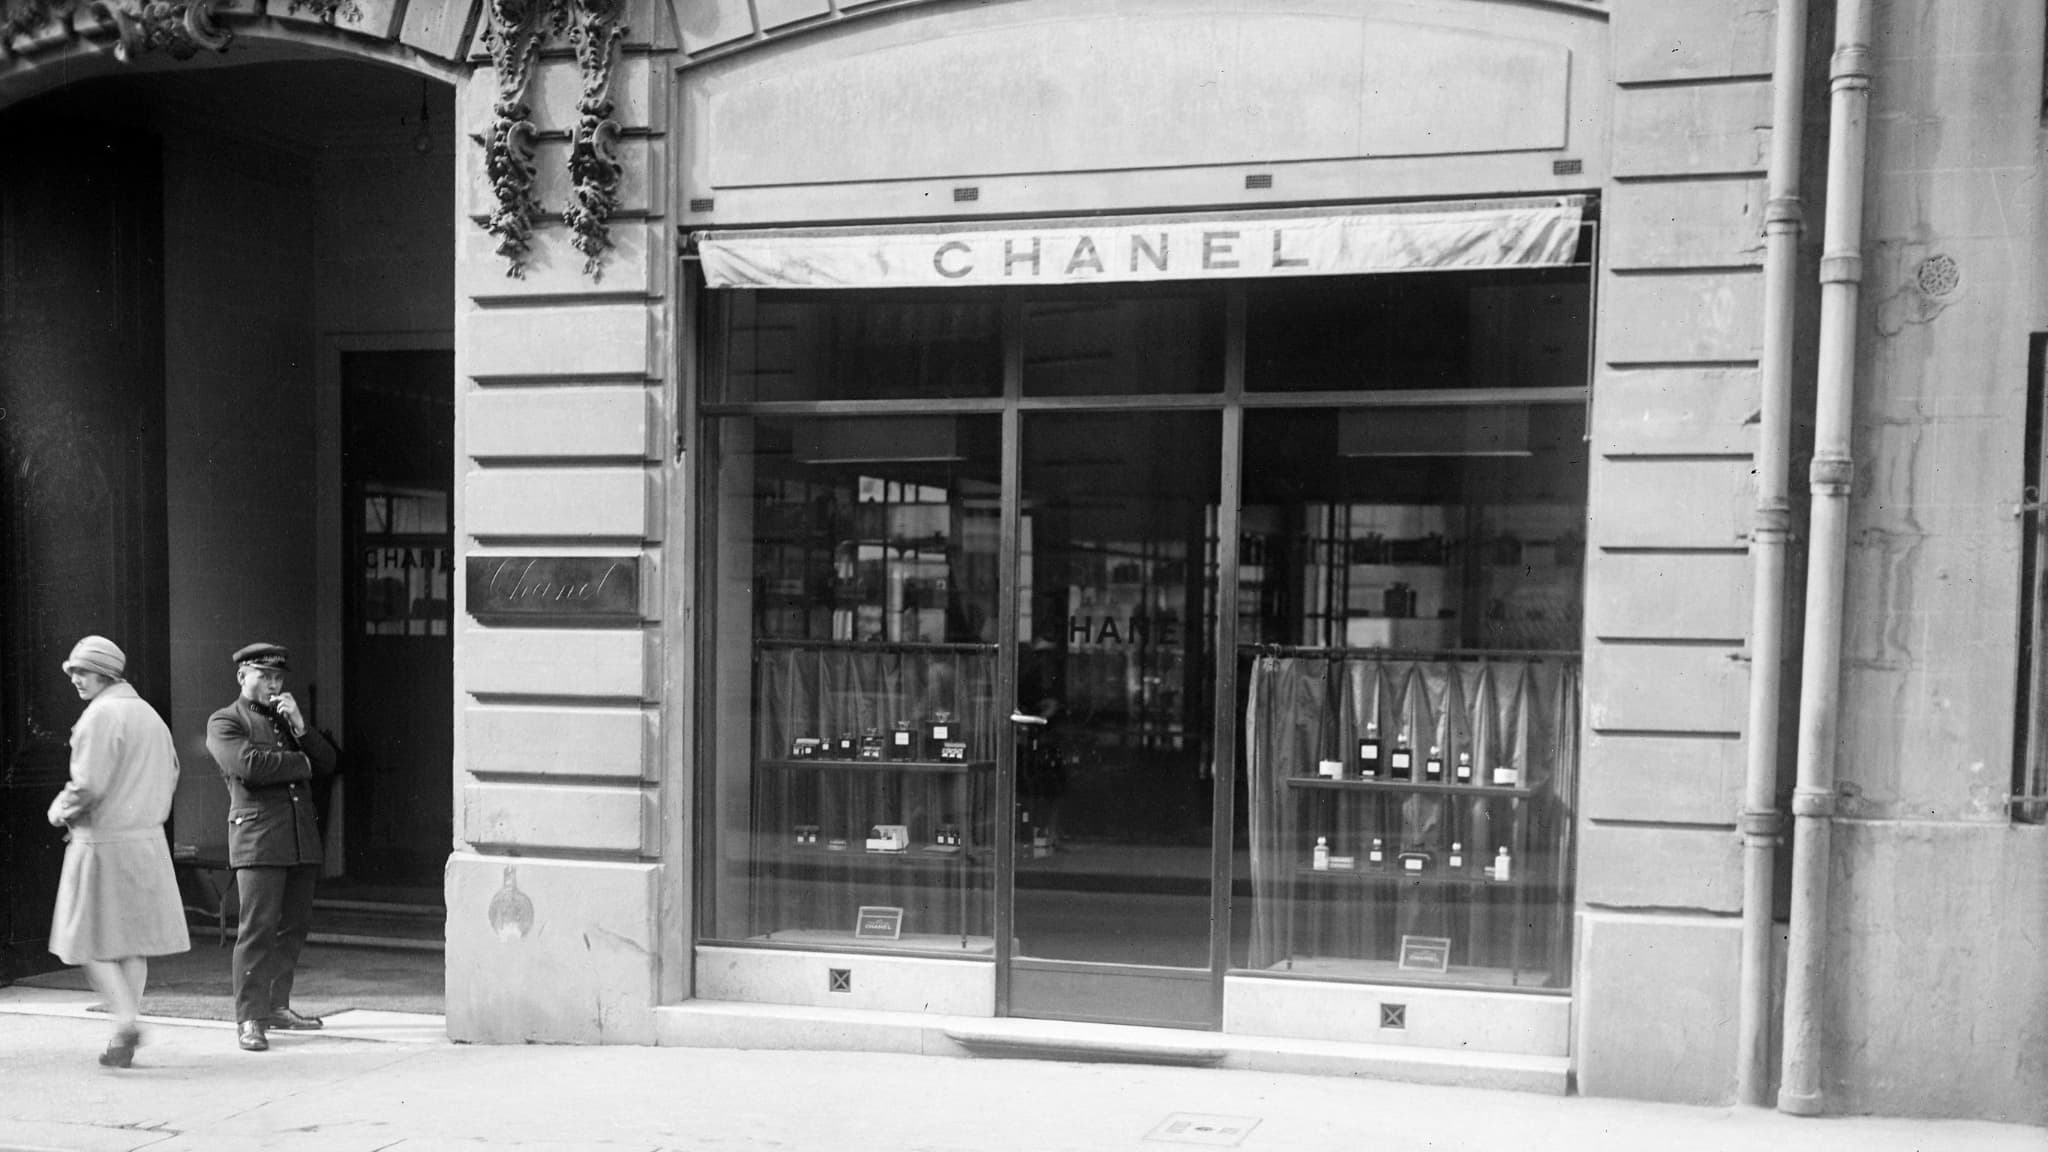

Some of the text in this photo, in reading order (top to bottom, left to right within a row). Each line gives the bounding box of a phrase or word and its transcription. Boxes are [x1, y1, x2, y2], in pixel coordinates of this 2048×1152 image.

[933, 229, 1309, 279] CHANEL
[364, 549, 450, 569] CHANE
[489, 559, 616, 601] Chanel
